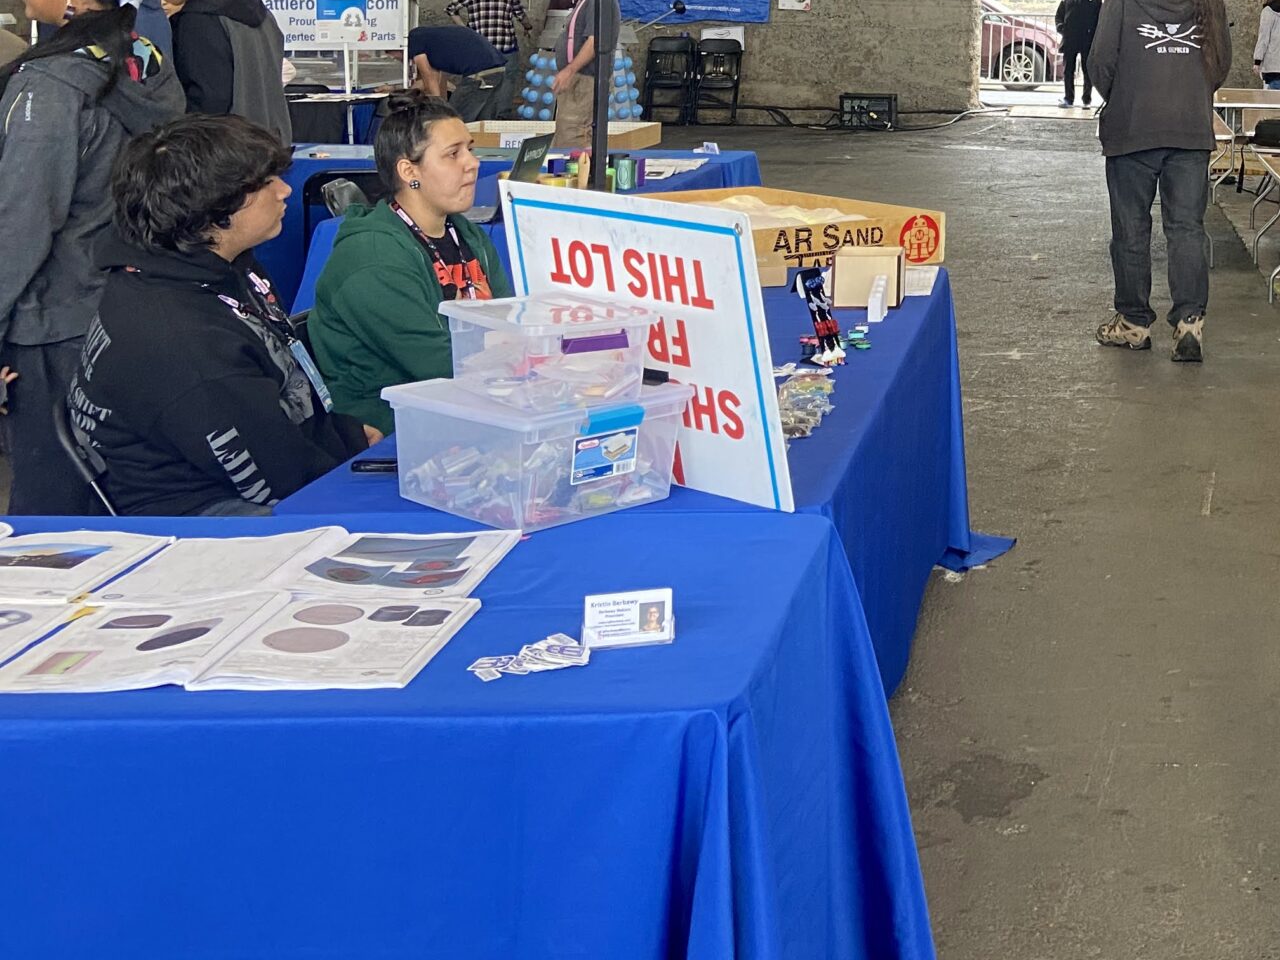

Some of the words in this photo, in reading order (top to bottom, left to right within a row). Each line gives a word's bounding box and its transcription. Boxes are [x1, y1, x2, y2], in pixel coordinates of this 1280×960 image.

[371, 31, 396, 41] Parts
[550, 237, 616, 293] LOT
[773, 229, 814, 255] AR
[622, 248, 715, 310] THIS
[647, 316, 692, 368] FR
[206, 425, 280, 506] WIFT
